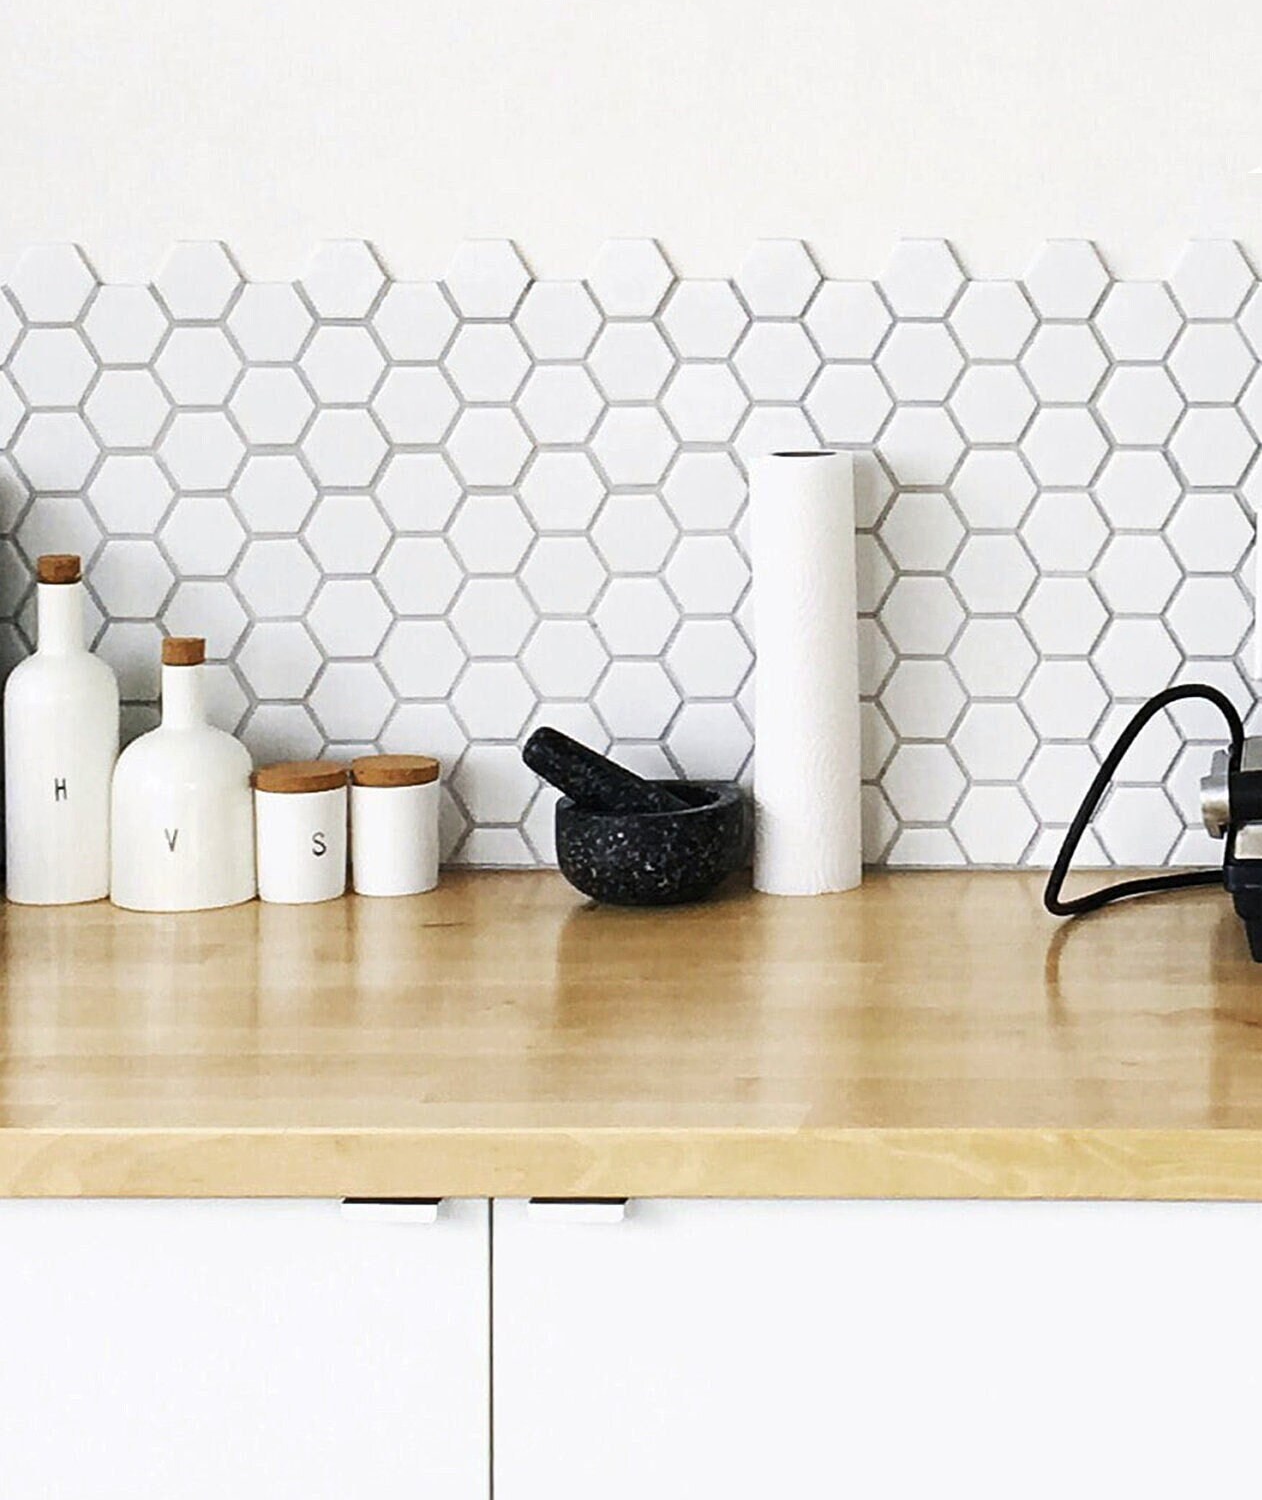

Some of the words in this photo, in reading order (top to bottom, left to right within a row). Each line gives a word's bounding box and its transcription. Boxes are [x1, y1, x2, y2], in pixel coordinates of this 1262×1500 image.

[54, 777, 68, 802] H
[165, 828, 178, 853] V
[311, 832, 327, 857] S
